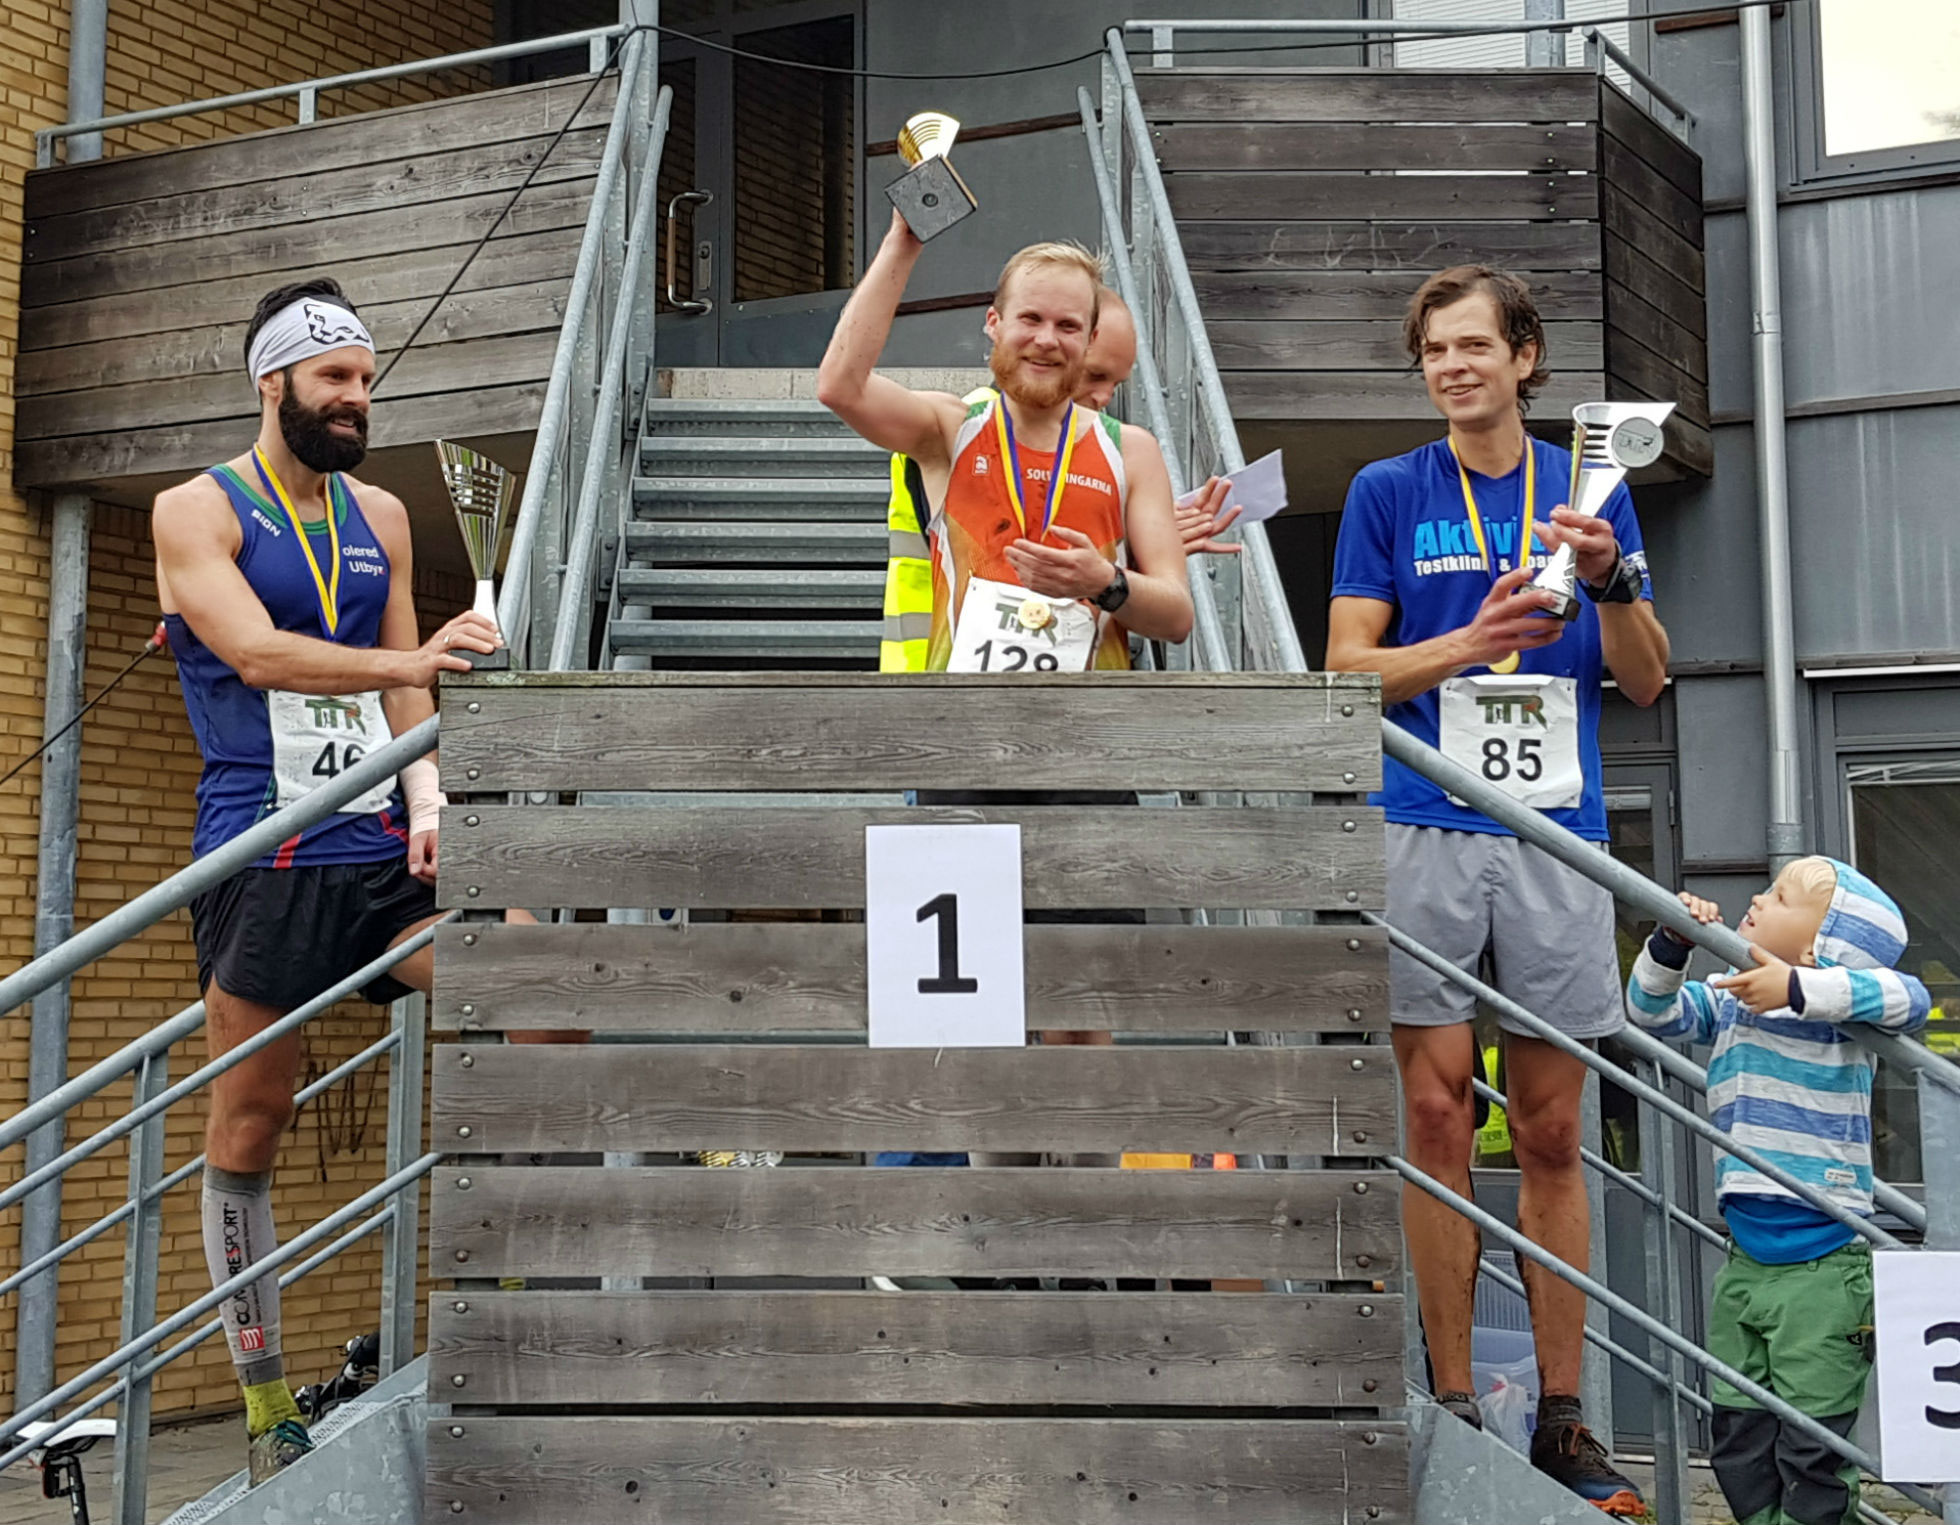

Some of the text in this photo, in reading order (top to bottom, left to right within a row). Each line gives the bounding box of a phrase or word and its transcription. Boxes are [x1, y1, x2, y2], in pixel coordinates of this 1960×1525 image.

[1026, 467, 1113, 496] SOLVINGARNA
[342, 544, 380, 558] olered
[1414, 516, 1551, 559] Aktivi
[1414, 555, 1489, 577] Testklin
[1499, 557, 1512, 572] &
[304, 698, 367, 736] TTR
[1475, 694, 1549, 731] TTR
[1481, 737, 1543, 782] 85
[916, 893, 978, 993] 1
[223, 1206, 250, 1326] COMRESSPORT
[1924, 1321, 1960, 1429] 3
